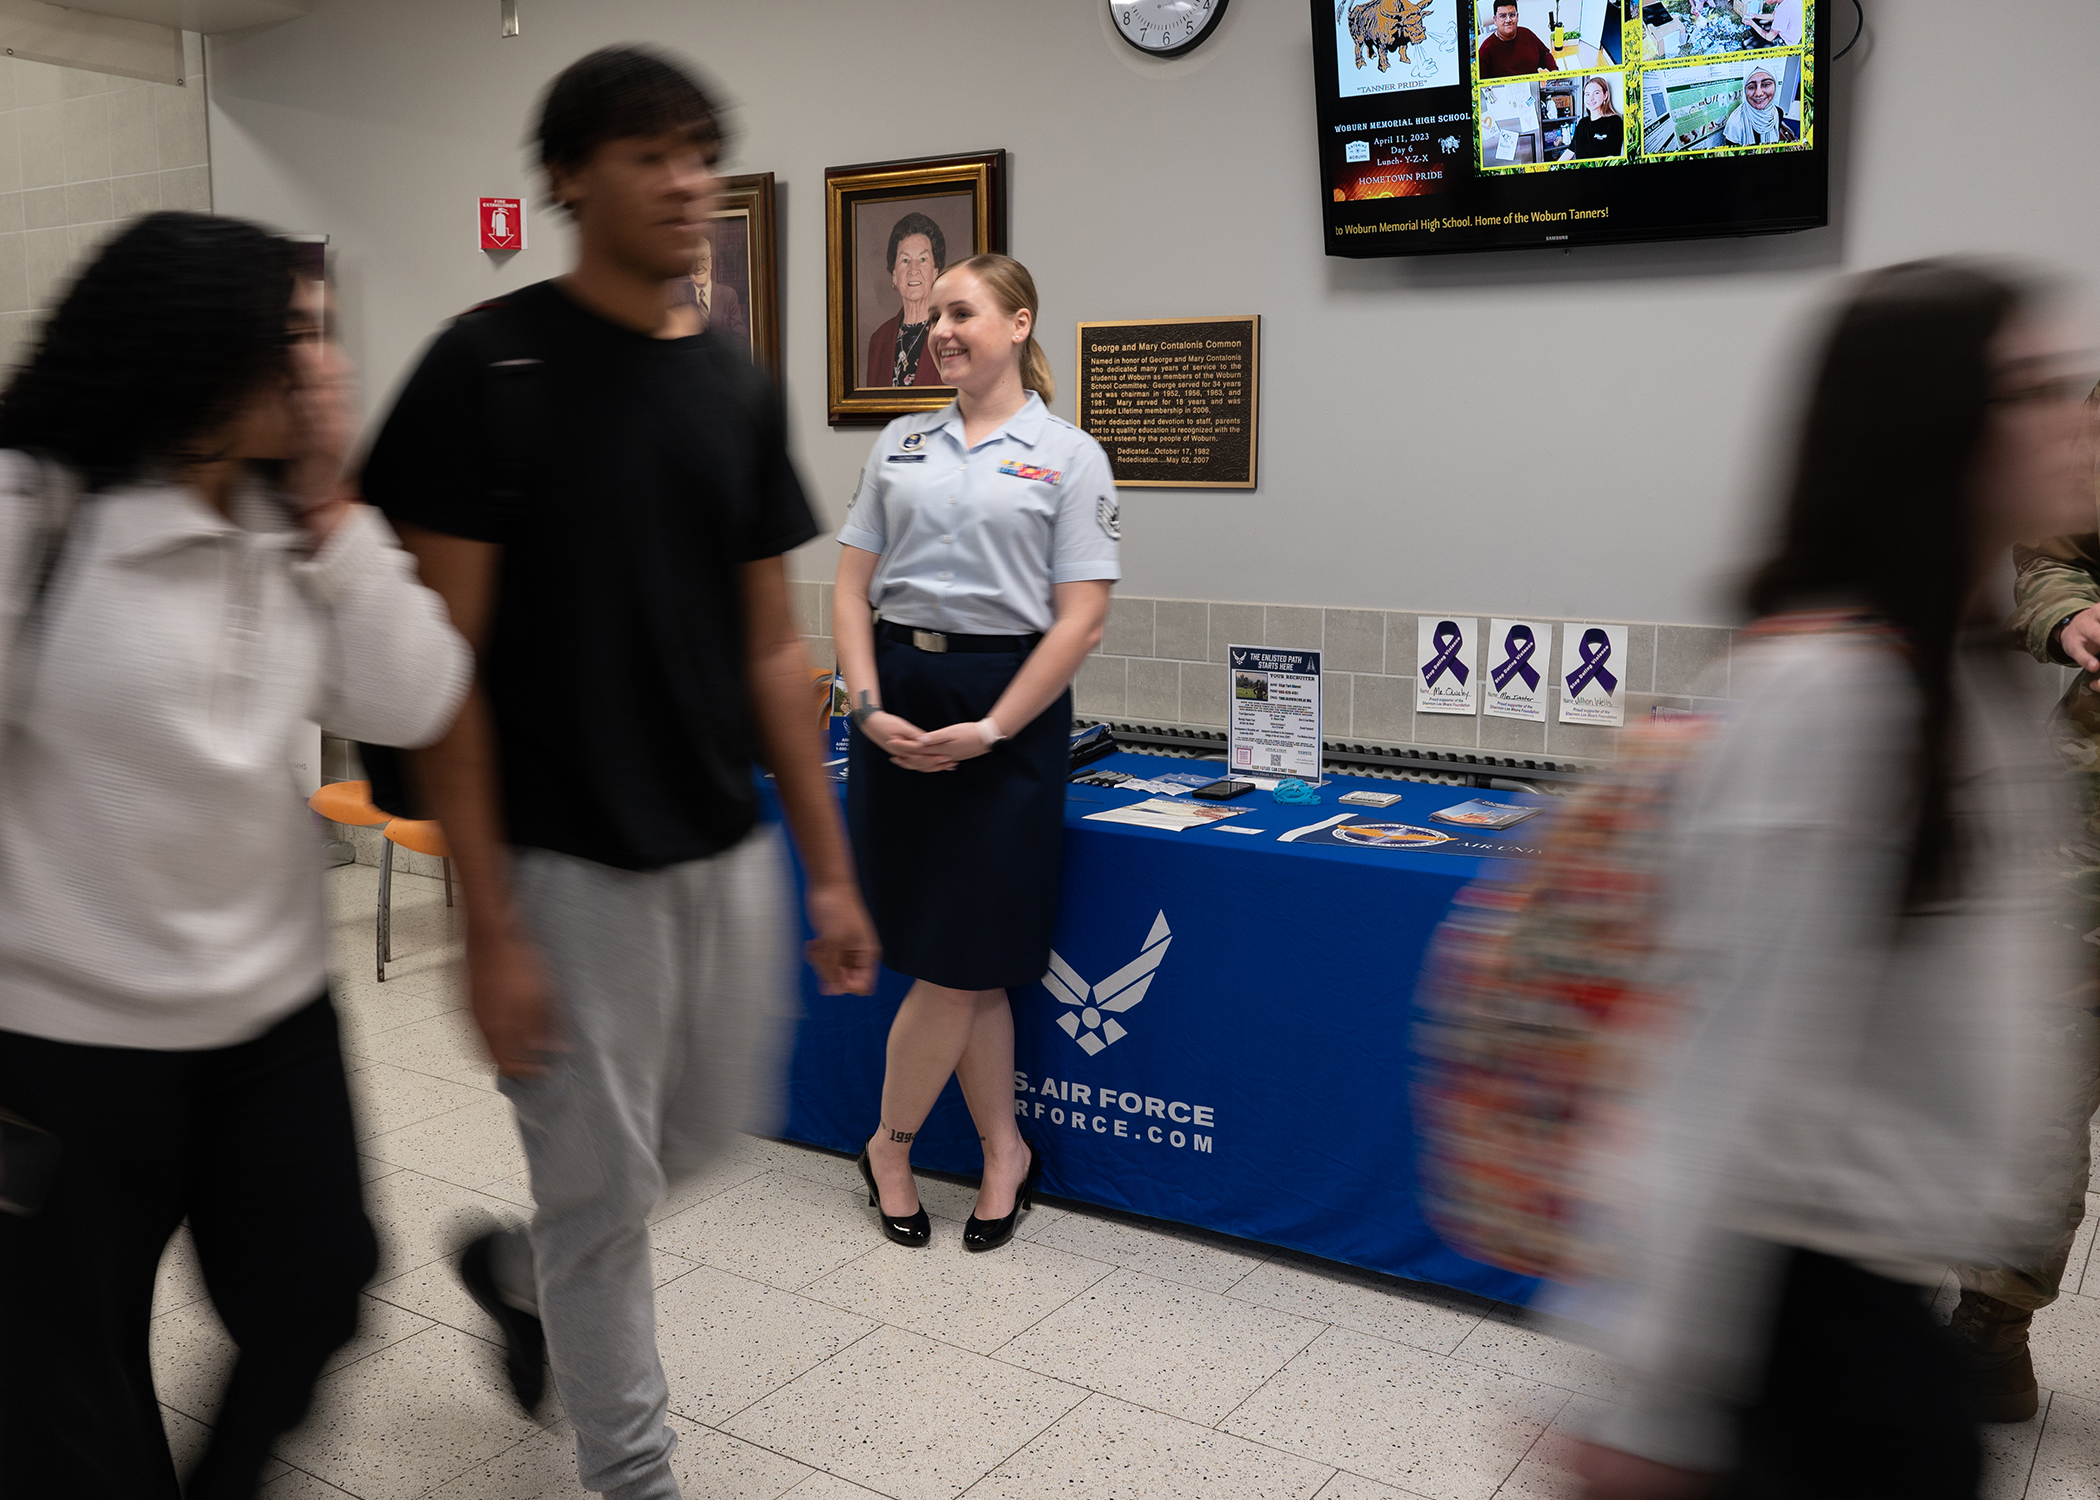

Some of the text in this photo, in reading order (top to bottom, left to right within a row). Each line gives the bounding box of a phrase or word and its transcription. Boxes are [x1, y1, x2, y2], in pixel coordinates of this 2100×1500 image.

[1123, 11, 1130, 25] 8
[1140, 28, 1147, 41] 7
[1186, 21, 1193, 35] 5
[1163, 32, 1170, 45] 6
[1357, 80, 1427, 93] "TANNER PRIDE"
[1335, 113, 1470, 132] WOBURN MEMORIAL HIGH SCHOOL
[1374, 133, 1429, 146] April 11, 2023
[1391, 147, 1405, 155] Day
[1377, 154, 1428, 166] Lunch- Y-Z-X
[1359, 171, 1443, 185] HOMETOWN PRIDE
[1335, 207, 1608, 235] to Woburn Memorial High School. Home of the Woburn Tanners!
[1091, 340, 1241, 353] George and Mary Contalonis Common
[1149, 356, 1172, 364] George
[1188, 355, 1204, 363] Mary
[1262, 654, 1286, 662] ENLISTED
[1280, 663, 1294, 671] HERE
[1015, 1071, 1214, 1127] S. AIR FORCE
[1015, 1099, 1212, 1154] RFORCE.COM
